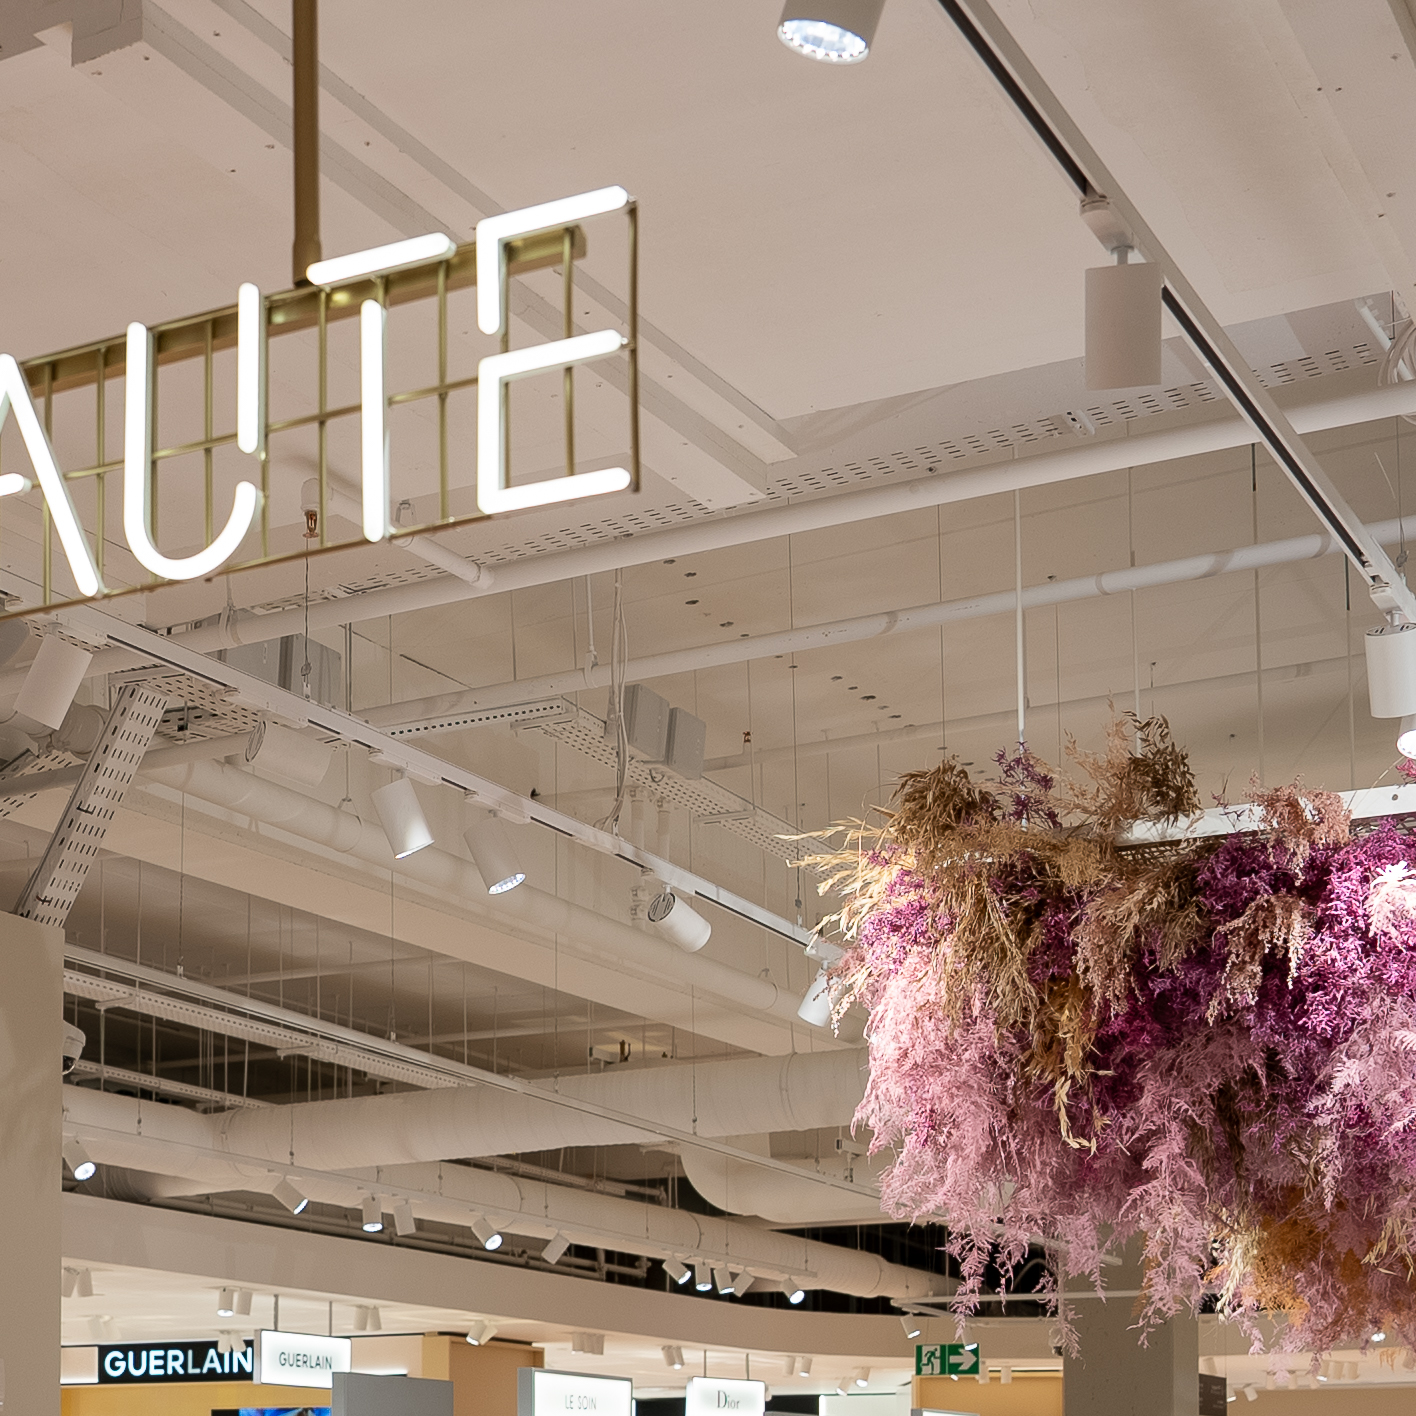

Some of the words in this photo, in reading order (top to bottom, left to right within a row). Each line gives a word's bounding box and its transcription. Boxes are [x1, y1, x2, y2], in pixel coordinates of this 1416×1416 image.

[104, 1346, 253, 1377] GUERLAIN
[279, 1352, 332, 1370] GUERLAIN
[565, 1394, 574, 1410] LE
[577, 1395, 597, 1410] SOIN
[716, 1389, 741, 1410] Dior
